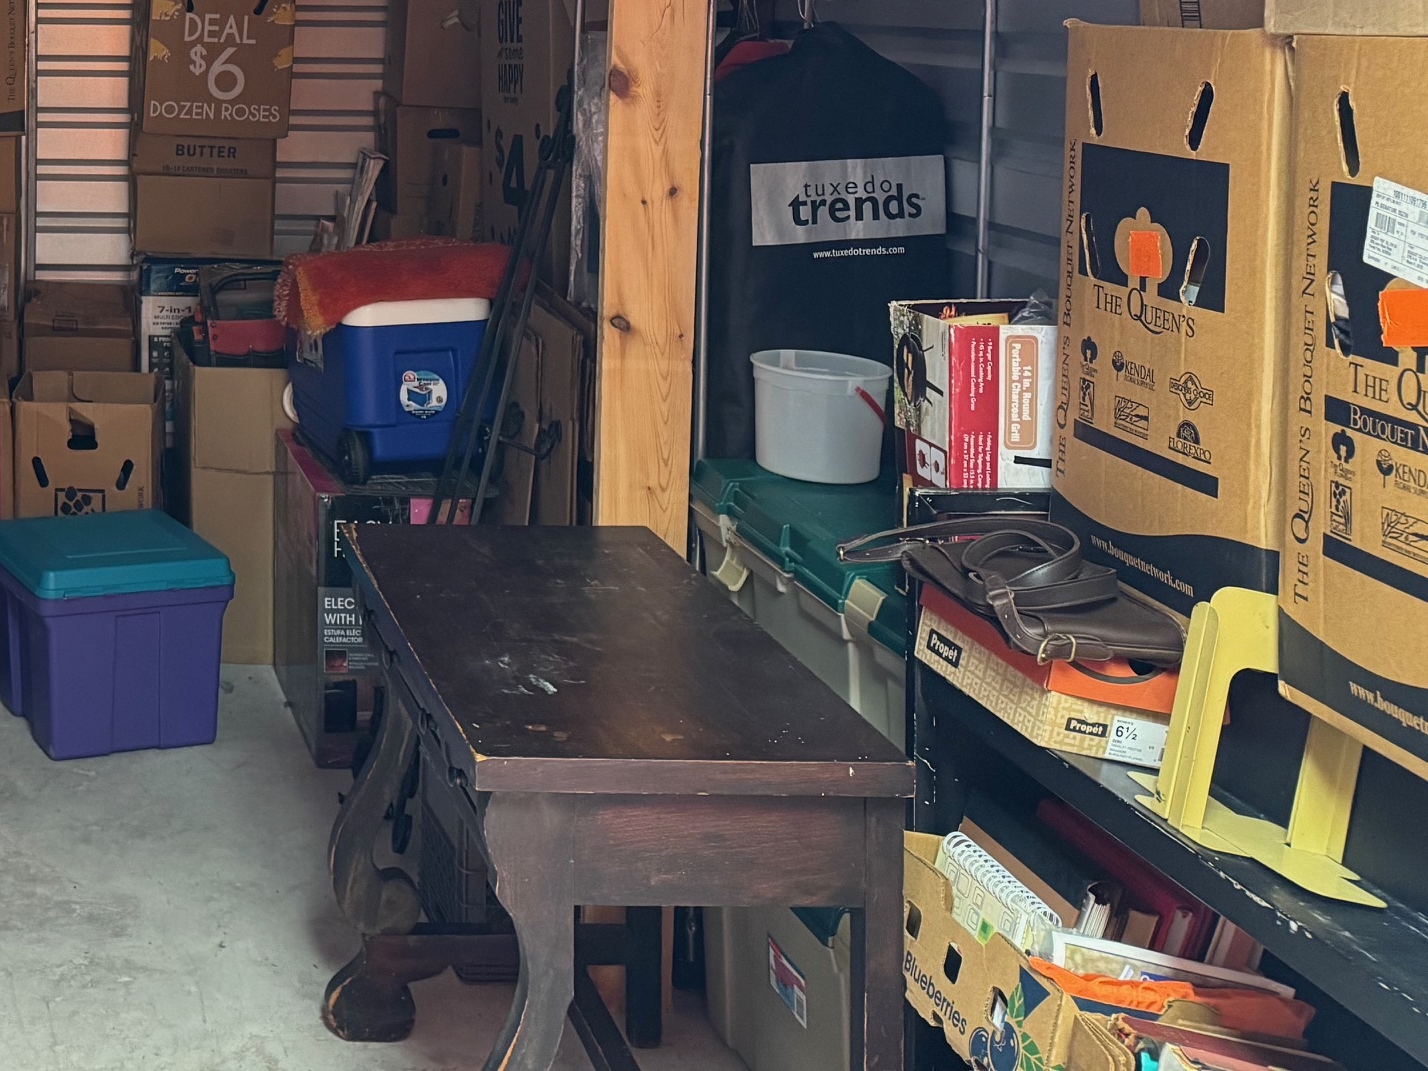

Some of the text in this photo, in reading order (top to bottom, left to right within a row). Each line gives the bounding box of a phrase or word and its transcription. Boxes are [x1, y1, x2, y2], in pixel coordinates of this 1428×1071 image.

[183, 13, 257, 45] DEAL
[497, 0, 523, 44] GIVE
[189, 44, 246, 101] $6
[498, 64, 524, 94] HAPPY
[150, 100, 280, 123] DOZEN ROSES
[175, 144, 238, 159] BUTTER
[803, 174, 892, 198] tuxedo
[788, 183, 923, 227] trends
[813, 245, 905, 259] www.tuxedotrends.com
[157, 305, 192, 314] 7-in-1
[1056, 138, 1078, 478] THE QUEEN'S BOUQUET NETWORK
[1093, 284, 1196, 338] THE QUEEN'S
[1125, 359, 1156, 383] KENDAL
[1349, 361, 1390, 404] THE
[1010, 343, 1021, 442] Portable Charcoal Grill
[1022, 365, 1032, 421] 14 in. Round
[1290, 178, 1320, 606] THE QUEEN'S BOUQUET NETWORK
[1349, 404, 1415, 448] BOUQUET
[1168, 436, 1212, 461] FLOREXPO
[1395, 461, 1428, 489] KEND
[1090, 534, 1195, 598] www.bouquetnetwork.com
[324, 597, 355, 609] ELEC
[324, 613, 355, 625] WITH
[930, 635, 959, 663] Propét
[1070, 721, 1103, 736] Propét
[904, 950, 967, 1036] Blueberries
